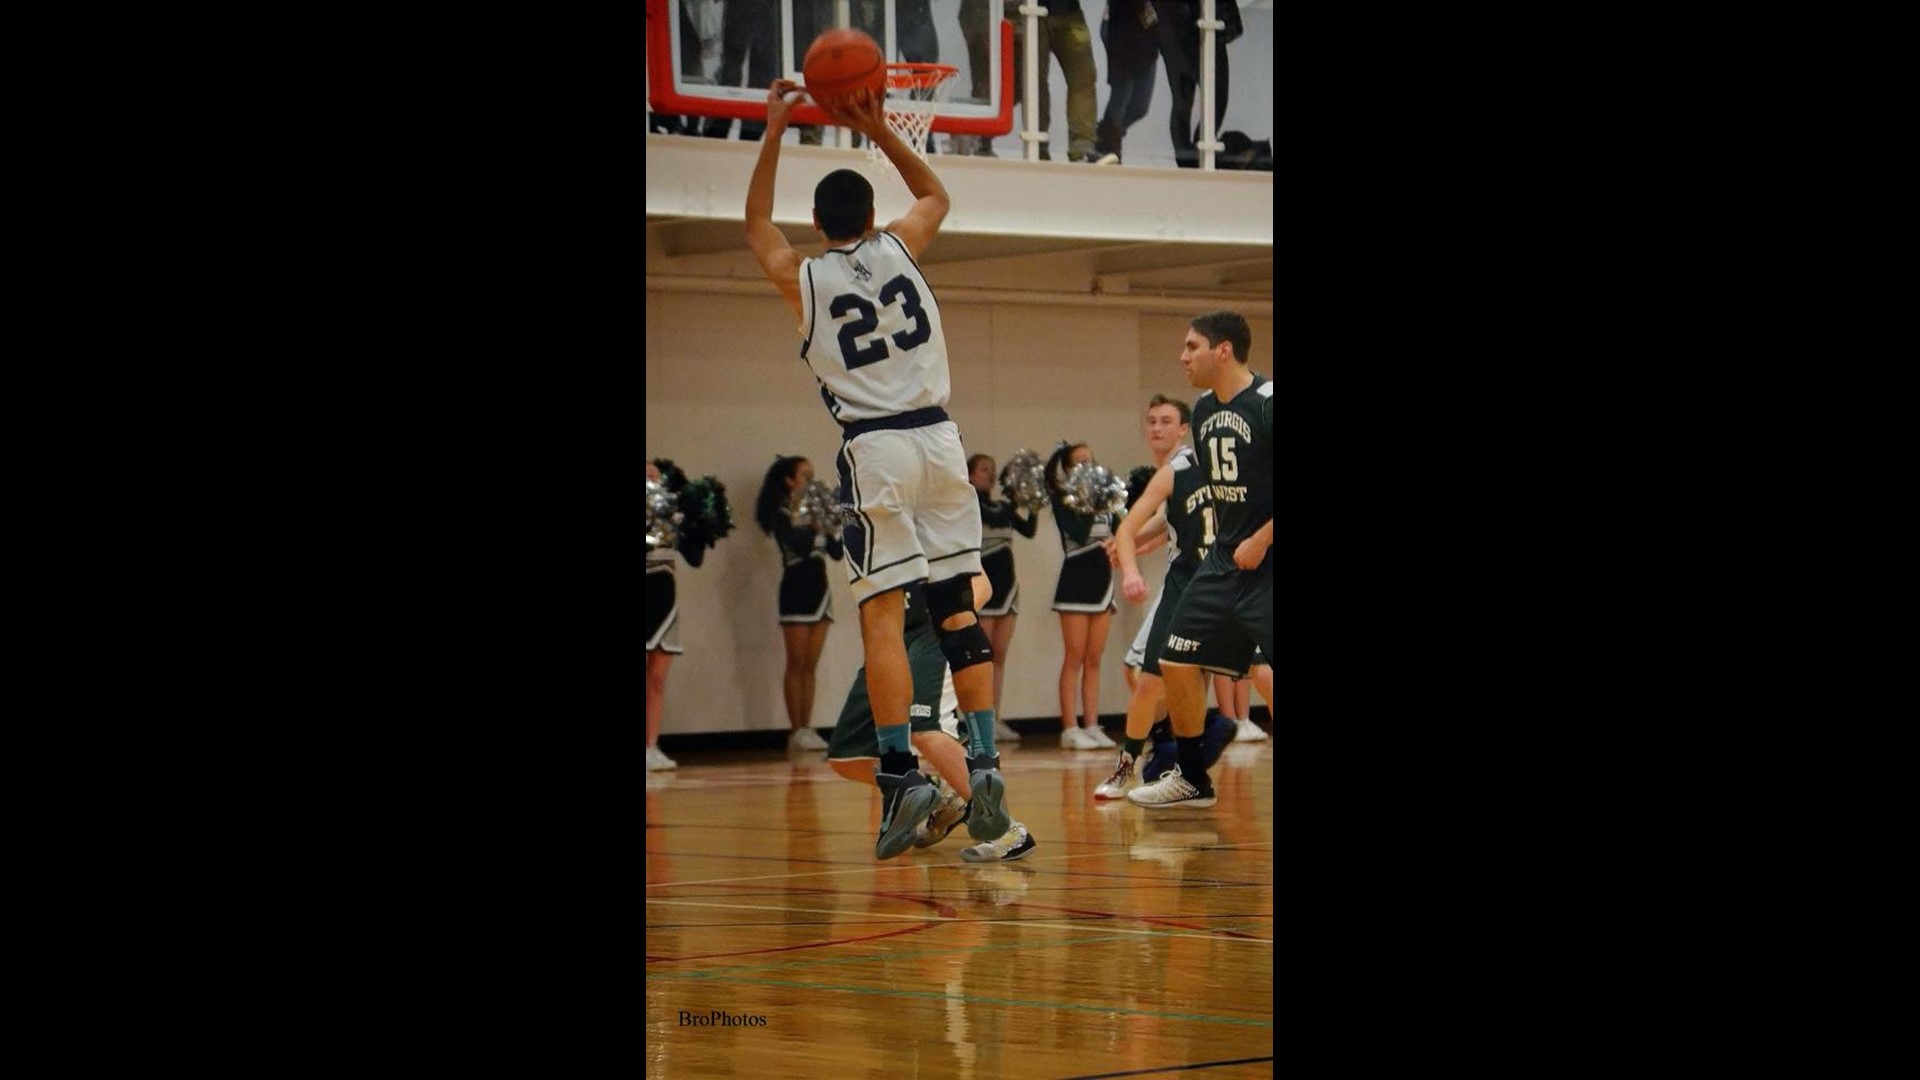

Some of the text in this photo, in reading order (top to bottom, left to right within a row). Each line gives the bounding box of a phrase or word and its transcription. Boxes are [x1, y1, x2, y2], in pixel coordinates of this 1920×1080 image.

[829, 274, 931, 371] 23
[1200, 410, 1251, 444] STURGIS
[1208, 437, 1239, 482] 15
[1202, 507, 1217, 545] 1
[1168, 634, 1201, 651] WEST
